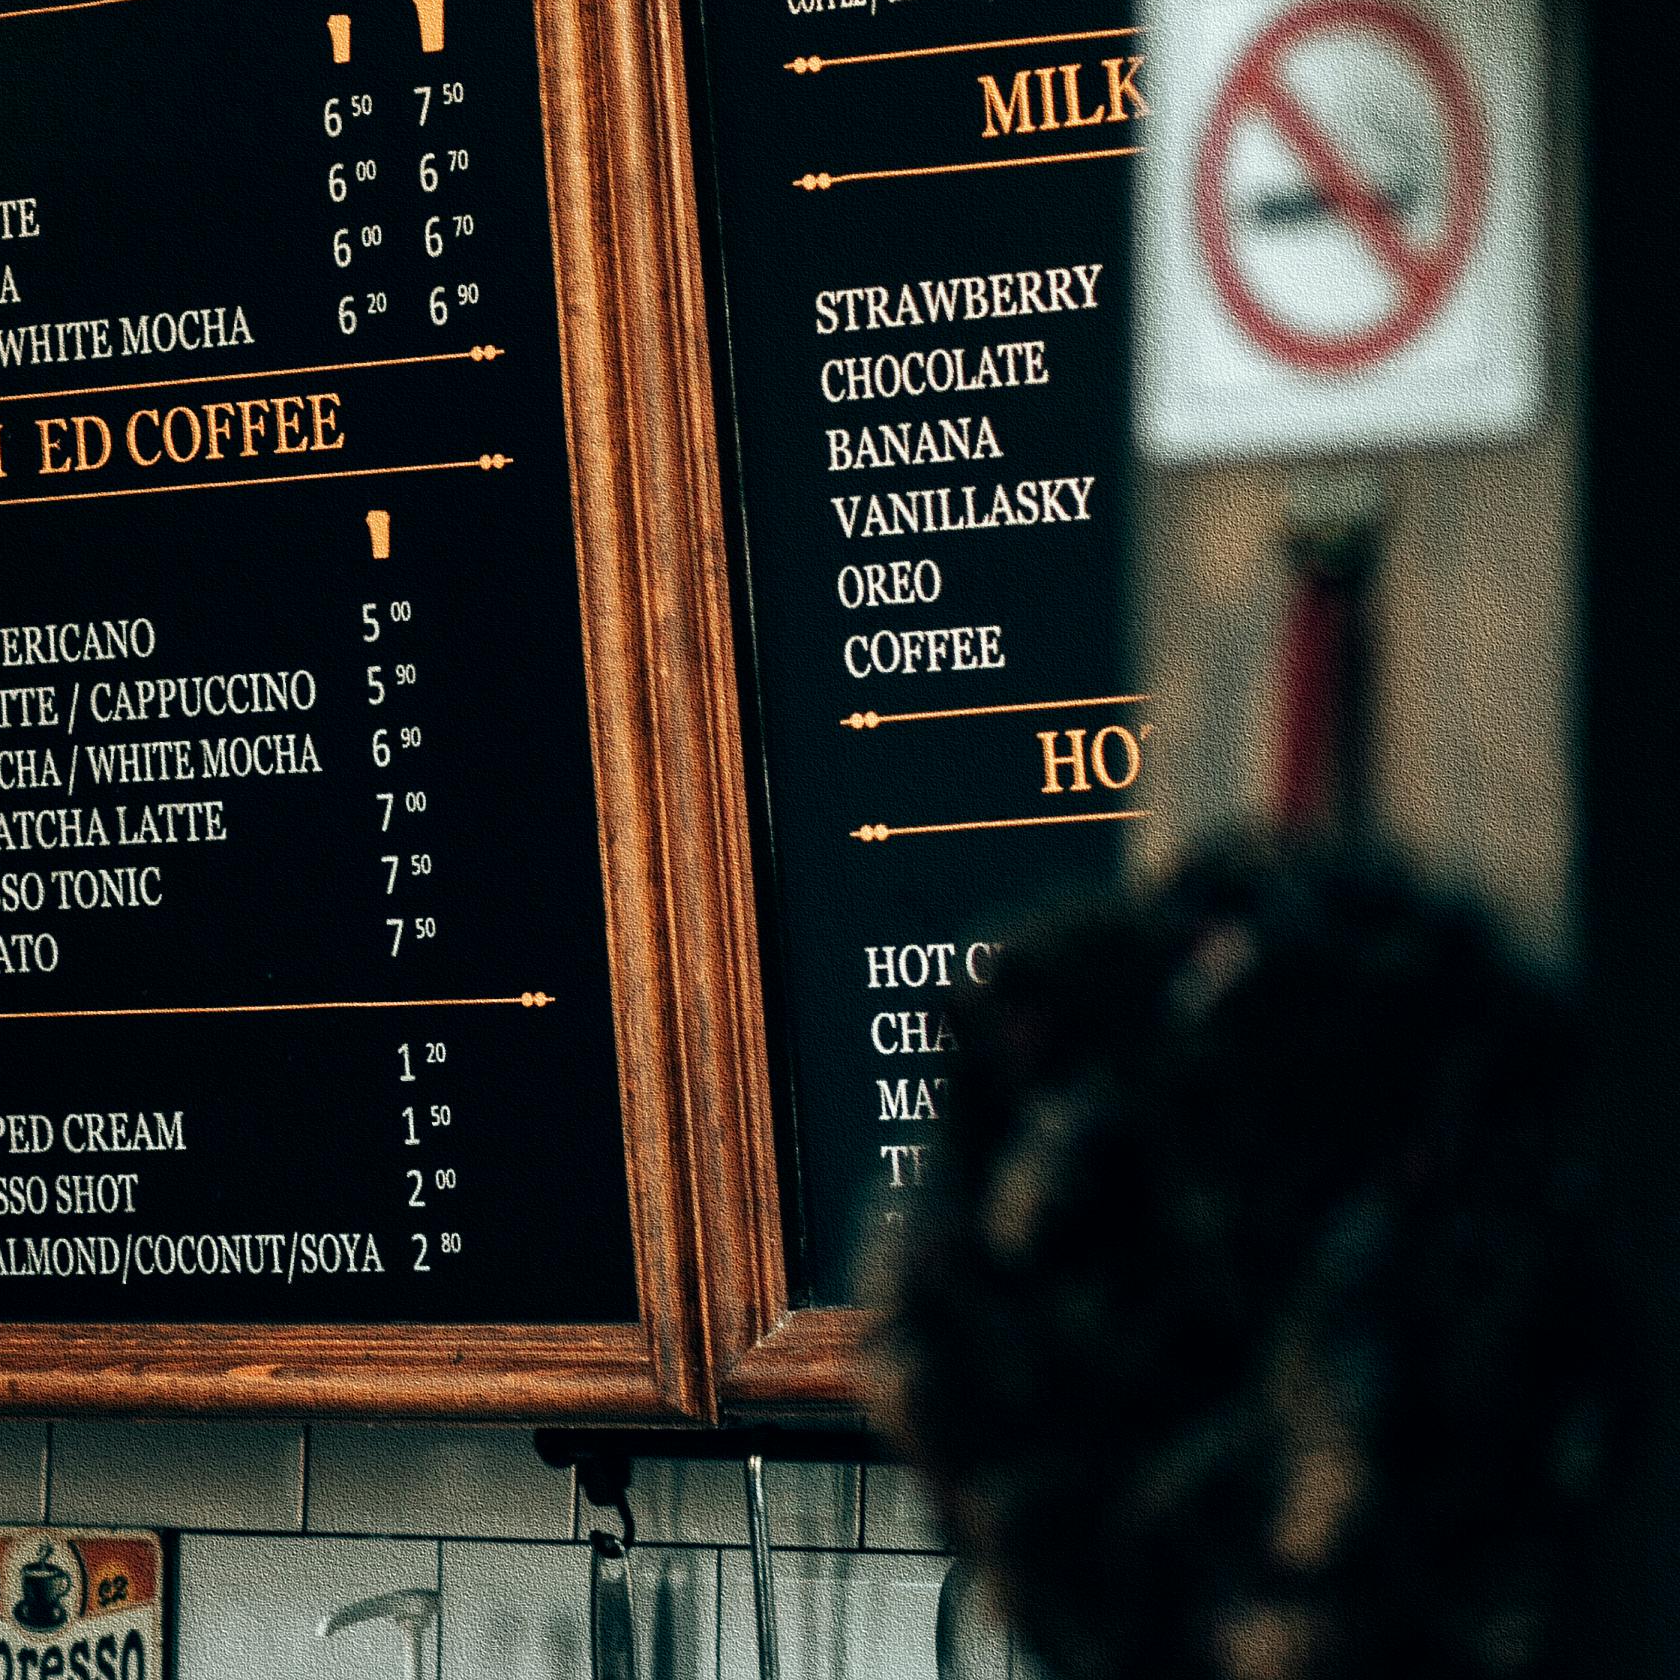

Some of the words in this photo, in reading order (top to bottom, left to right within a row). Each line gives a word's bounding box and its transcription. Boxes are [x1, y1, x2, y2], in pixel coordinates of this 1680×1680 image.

[977, 55, 1152, 139] MILK
[816, 264, 1102, 334] STRAWBERRY
[120, 307, 254, 355] MOCHA
[821, 341, 1049, 403] CHOCOLATE
[126, 393, 345, 466] COFFEE
[826, 417, 1003, 471] BANANA
[831, 477, 1094, 538] VANILLASKY
[837, 559, 941, 609] OREO
[844, 625, 1005, 678] COFFEE
[91, 670, 316, 722] CAPPUCCINO
[86, 741, 194, 782] WHITE
[201, 734, 322, 778] MOCHA
[1036, 725, 1157, 794] HO
[117, 801, 226, 844] LATTE
[52, 867, 162, 909] TONIC
[865, 943, 955, 988] HOT
[876, 1079, 952, 1122] MA
[63, 1112, 186, 1153] CREAM
[56, 1174, 138, 1213] SHOT
